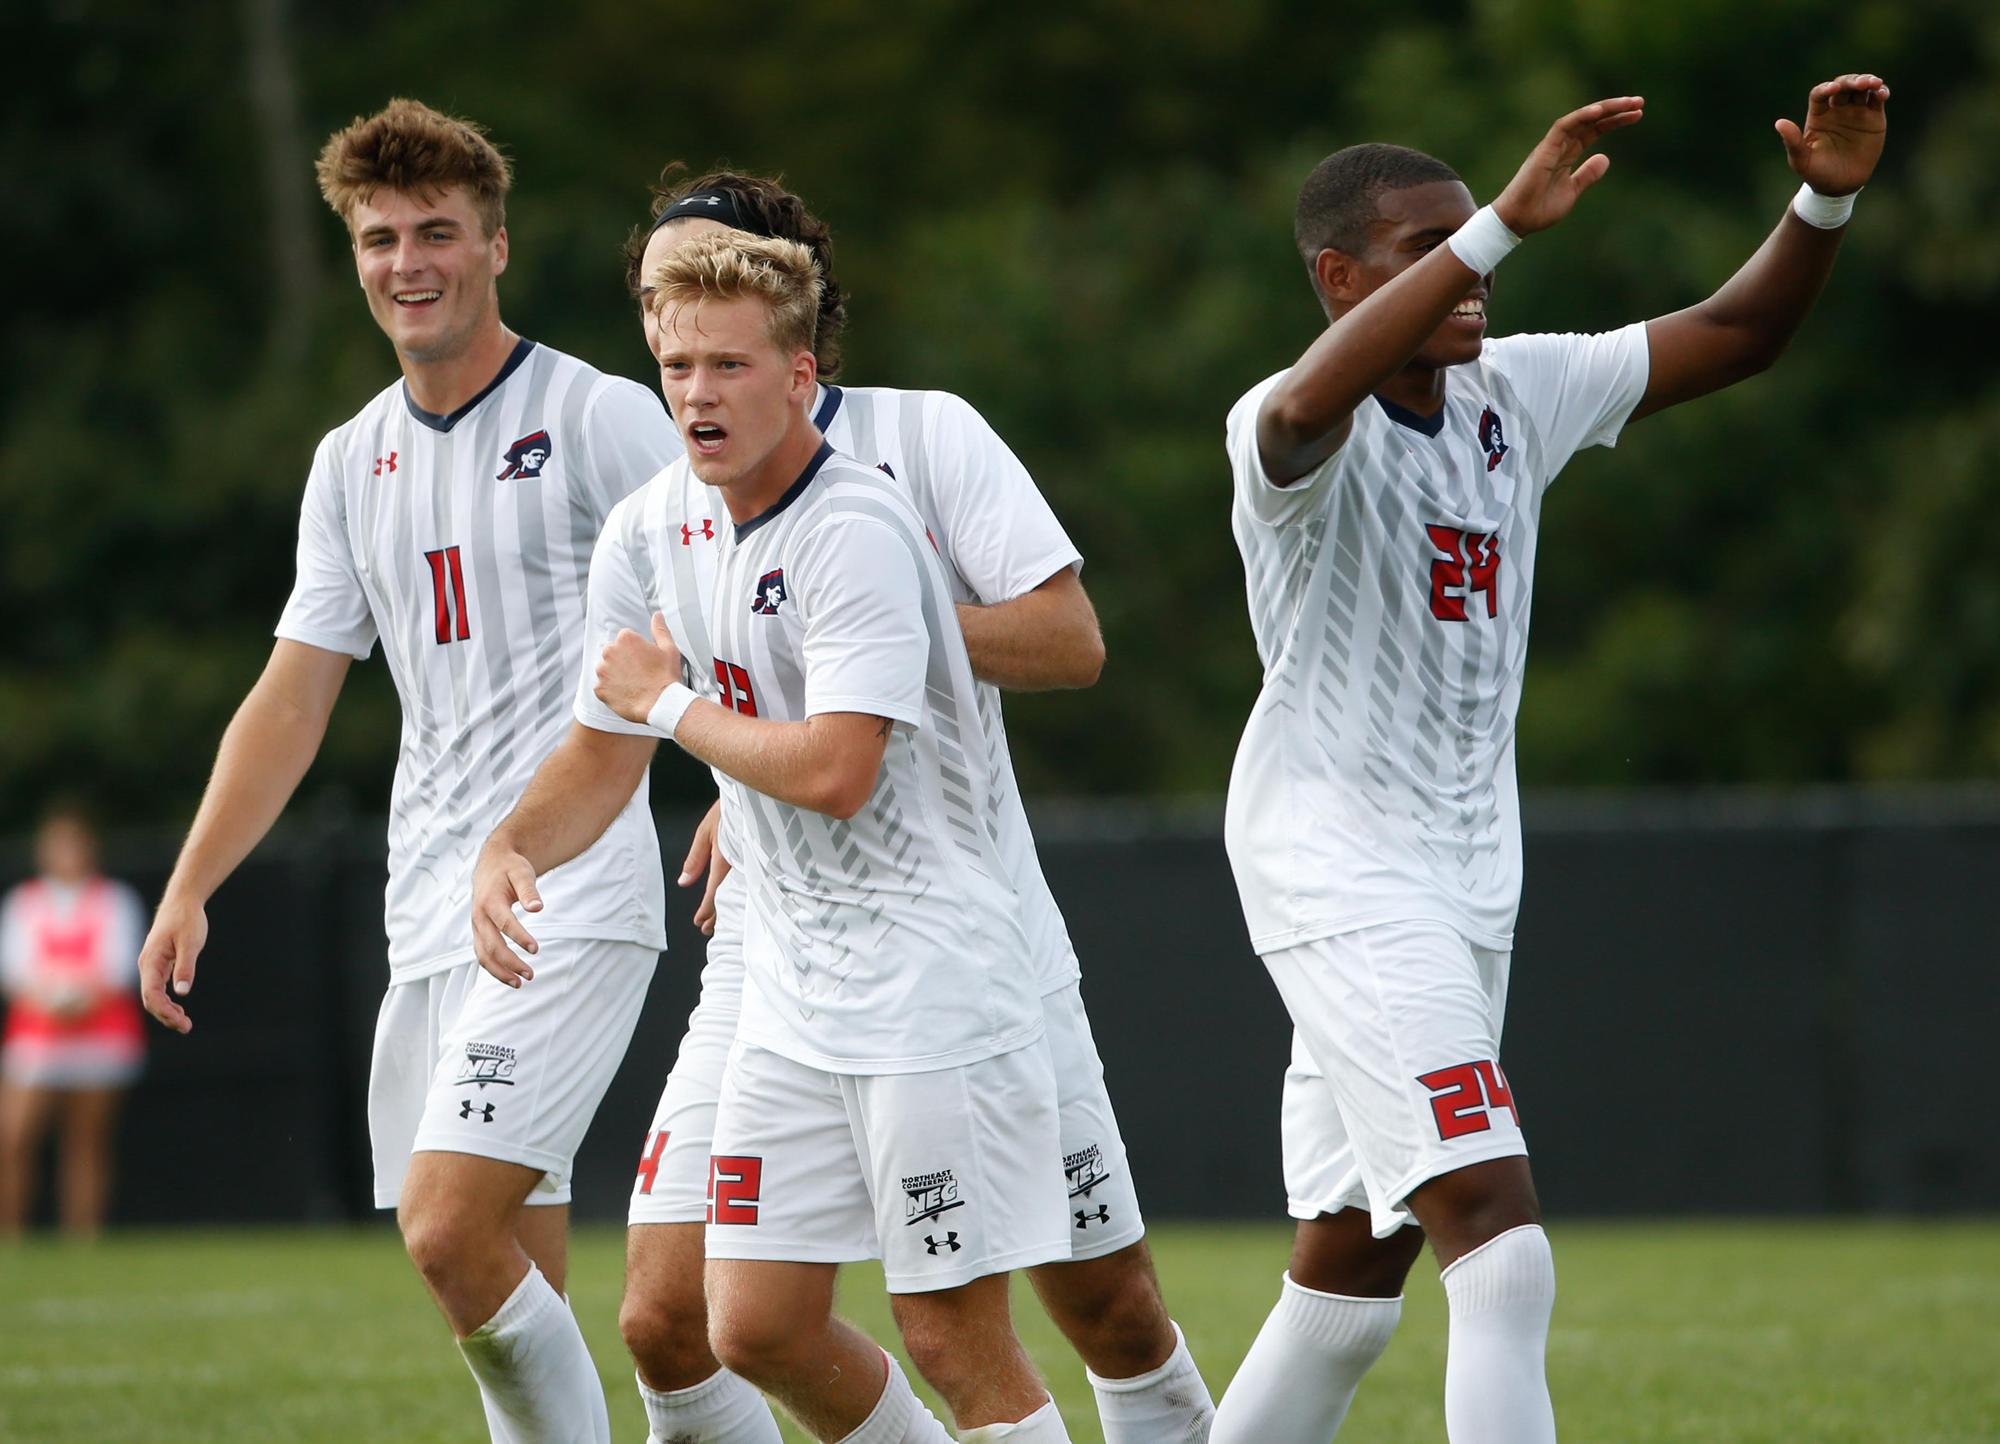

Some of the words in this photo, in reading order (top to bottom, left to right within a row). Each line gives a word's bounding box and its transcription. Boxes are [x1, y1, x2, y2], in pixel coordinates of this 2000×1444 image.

[1424, 522, 1501, 622] 24
[423, 545, 471, 645] 11
[465, 1047, 515, 1060] CONFERENCE
[466, 1041, 516, 1054] NORTHEAST
[457, 1059, 517, 1078] NEC
[1413, 1059, 1520, 1141] 24
[1062, 1143, 1098, 1163] ORTHEAST
[901, 1169, 951, 1184] NORTHEAST
[902, 1175, 953, 1190] CONFERENCE
[706, 1155, 763, 1226] 2
[906, 1179, 958, 1218] NEC
